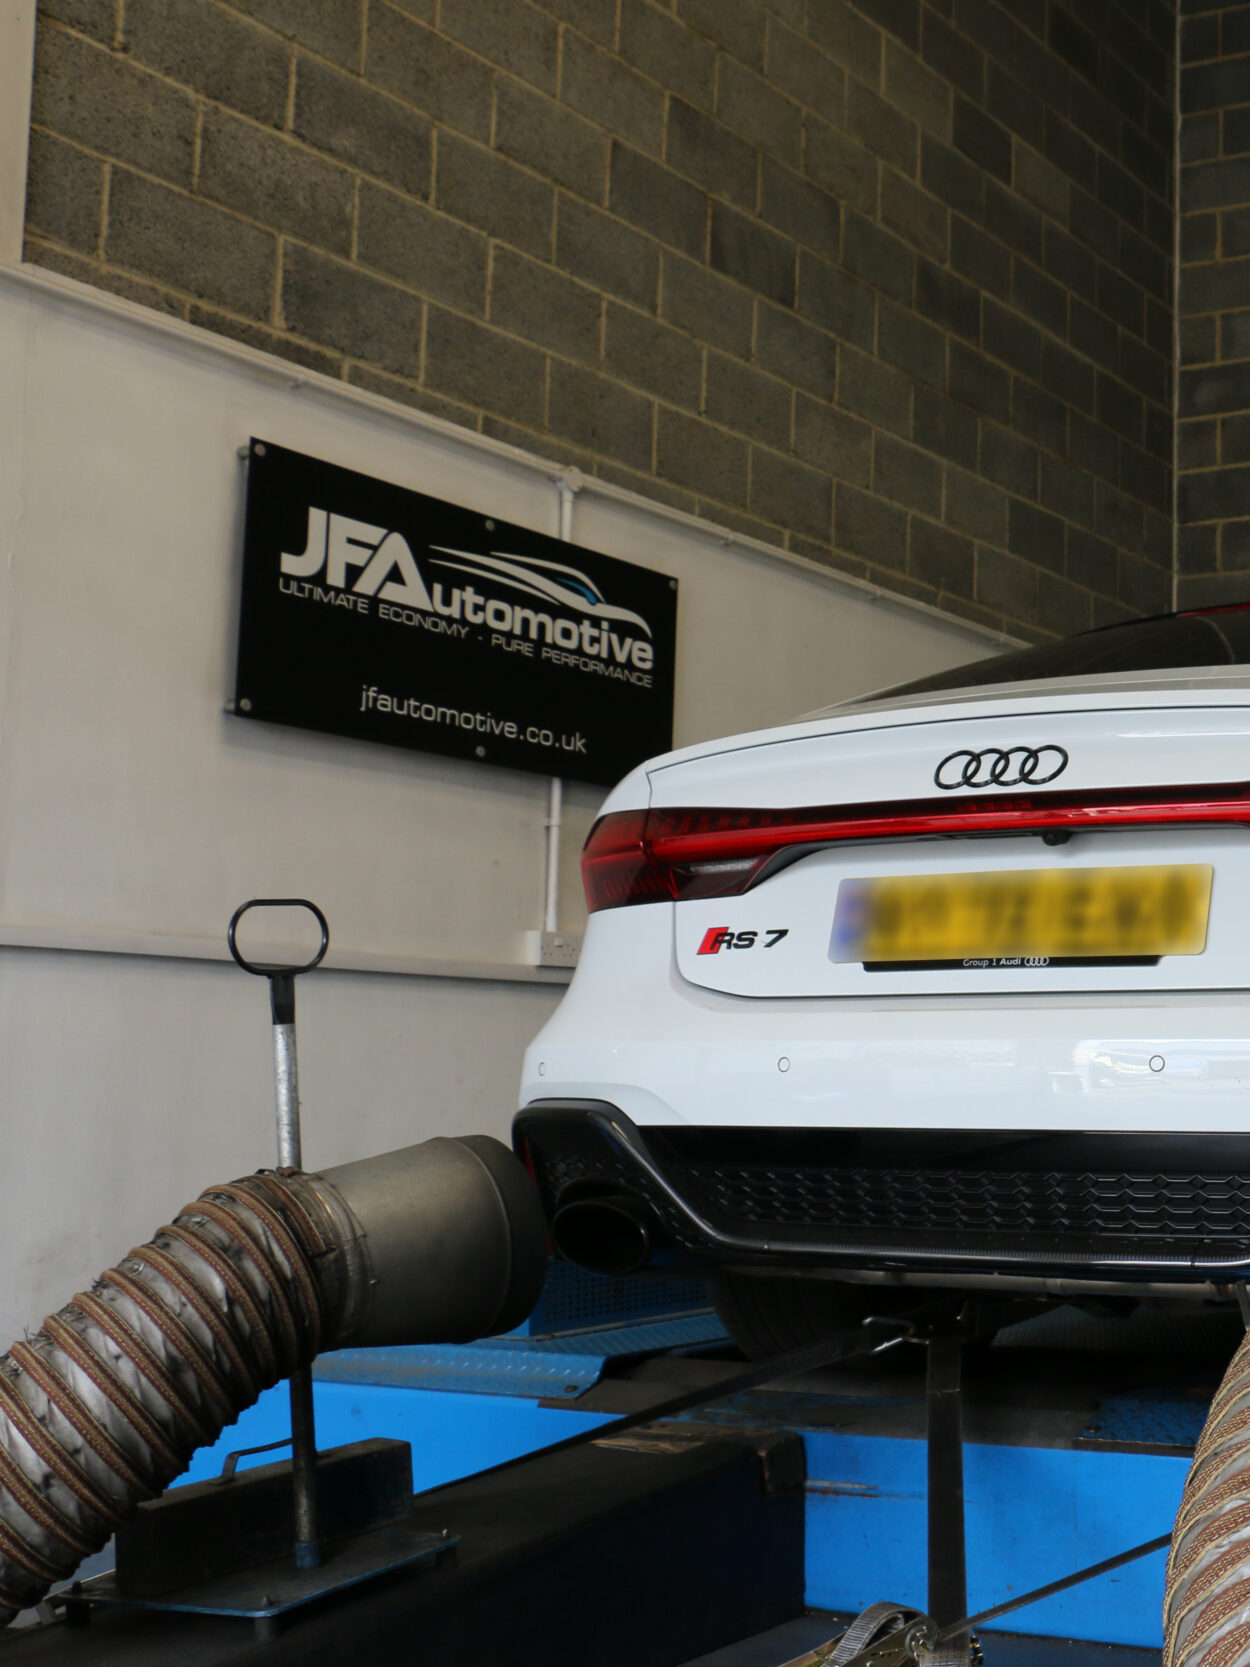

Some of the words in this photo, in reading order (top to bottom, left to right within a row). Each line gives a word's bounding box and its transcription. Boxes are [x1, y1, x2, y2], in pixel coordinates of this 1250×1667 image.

[279, 577, 369, 614] ULTIMATE
[378, 603, 470, 639] ECONOMY
[491, 634, 534, 657] PURE
[541, 647, 653, 688] PERFORMANCE
[360, 684, 587, 754] jfautomotive.co.uk
[707, 929, 759, 951] RS
[763, 929, 789, 949] 7
[962, 958, 989, 968] Group
[991, 958, 997, 966] 1
[999, 957, 1022, 966] Audi
